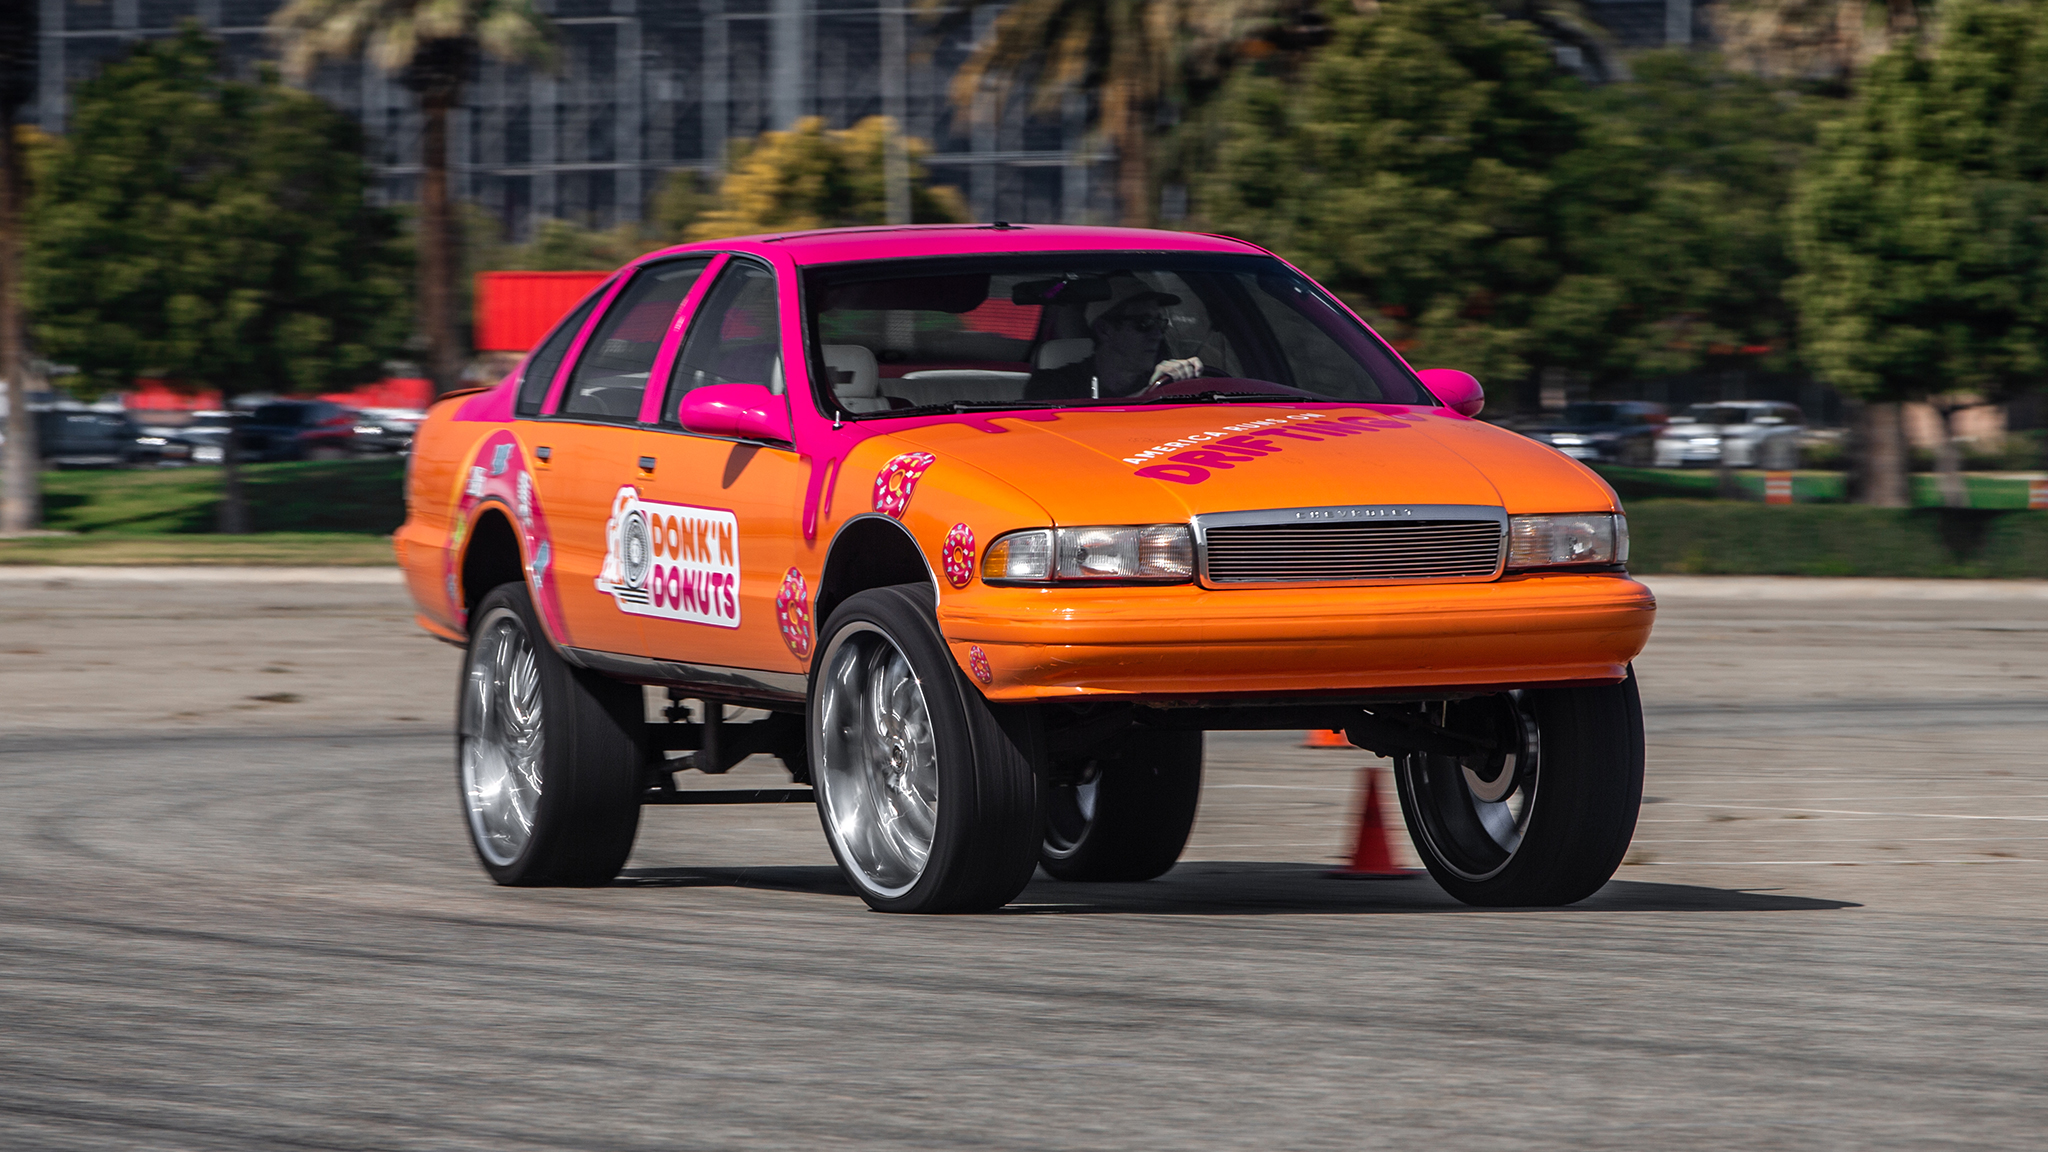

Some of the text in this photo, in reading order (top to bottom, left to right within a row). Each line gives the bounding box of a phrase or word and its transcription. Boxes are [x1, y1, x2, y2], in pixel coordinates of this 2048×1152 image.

[1122, 412, 1326, 465] AMERICA RUNS ON
[1133, 416, 1412, 485] DRIFTING
[651, 512, 734, 567] DONK'N
[1295, 508, 1414, 520] CHEVROLET
[653, 563, 735, 619] DONUTS
